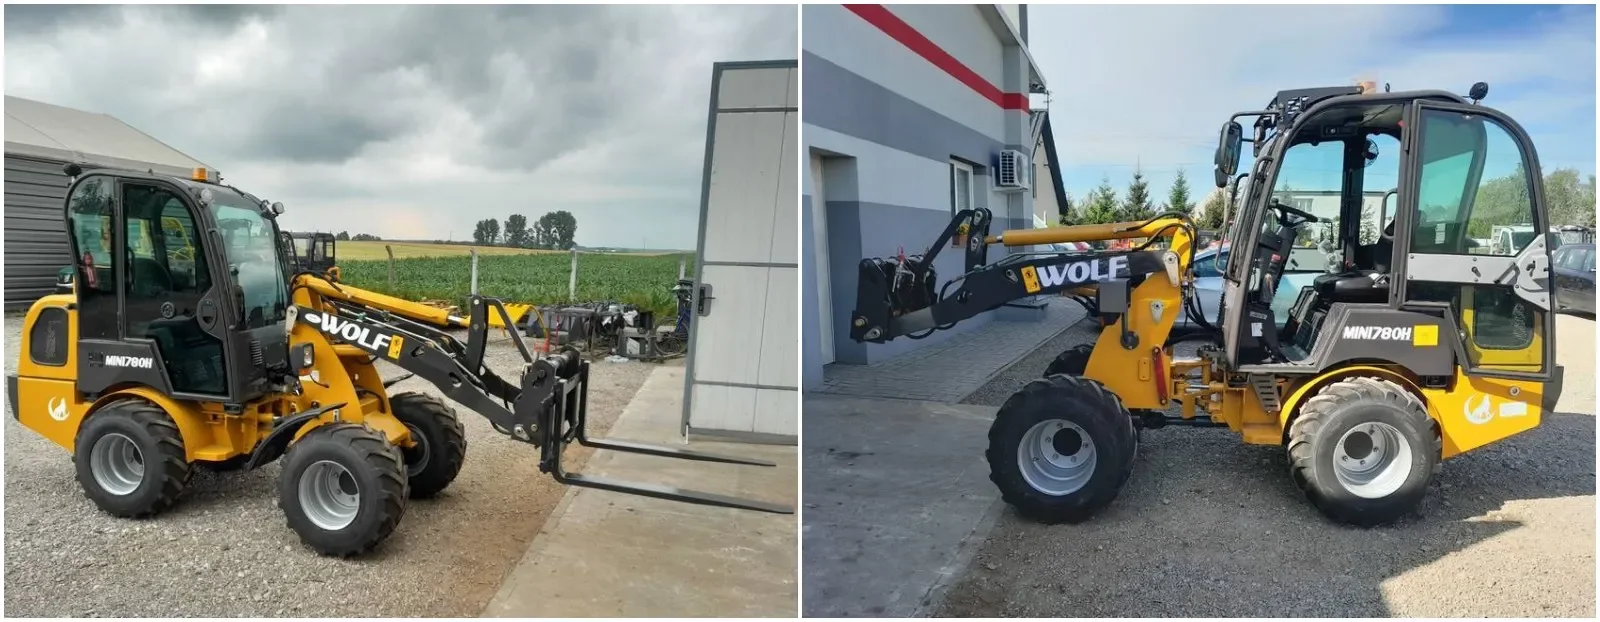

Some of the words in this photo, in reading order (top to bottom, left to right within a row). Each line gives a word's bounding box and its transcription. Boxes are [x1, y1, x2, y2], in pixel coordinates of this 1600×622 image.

[1037, 255, 1128, 287] WOLF
[321, 312, 392, 351] WOLF
[1343, 325, 1412, 341] MINI780H
[105, 355, 153, 369] MINI780H
